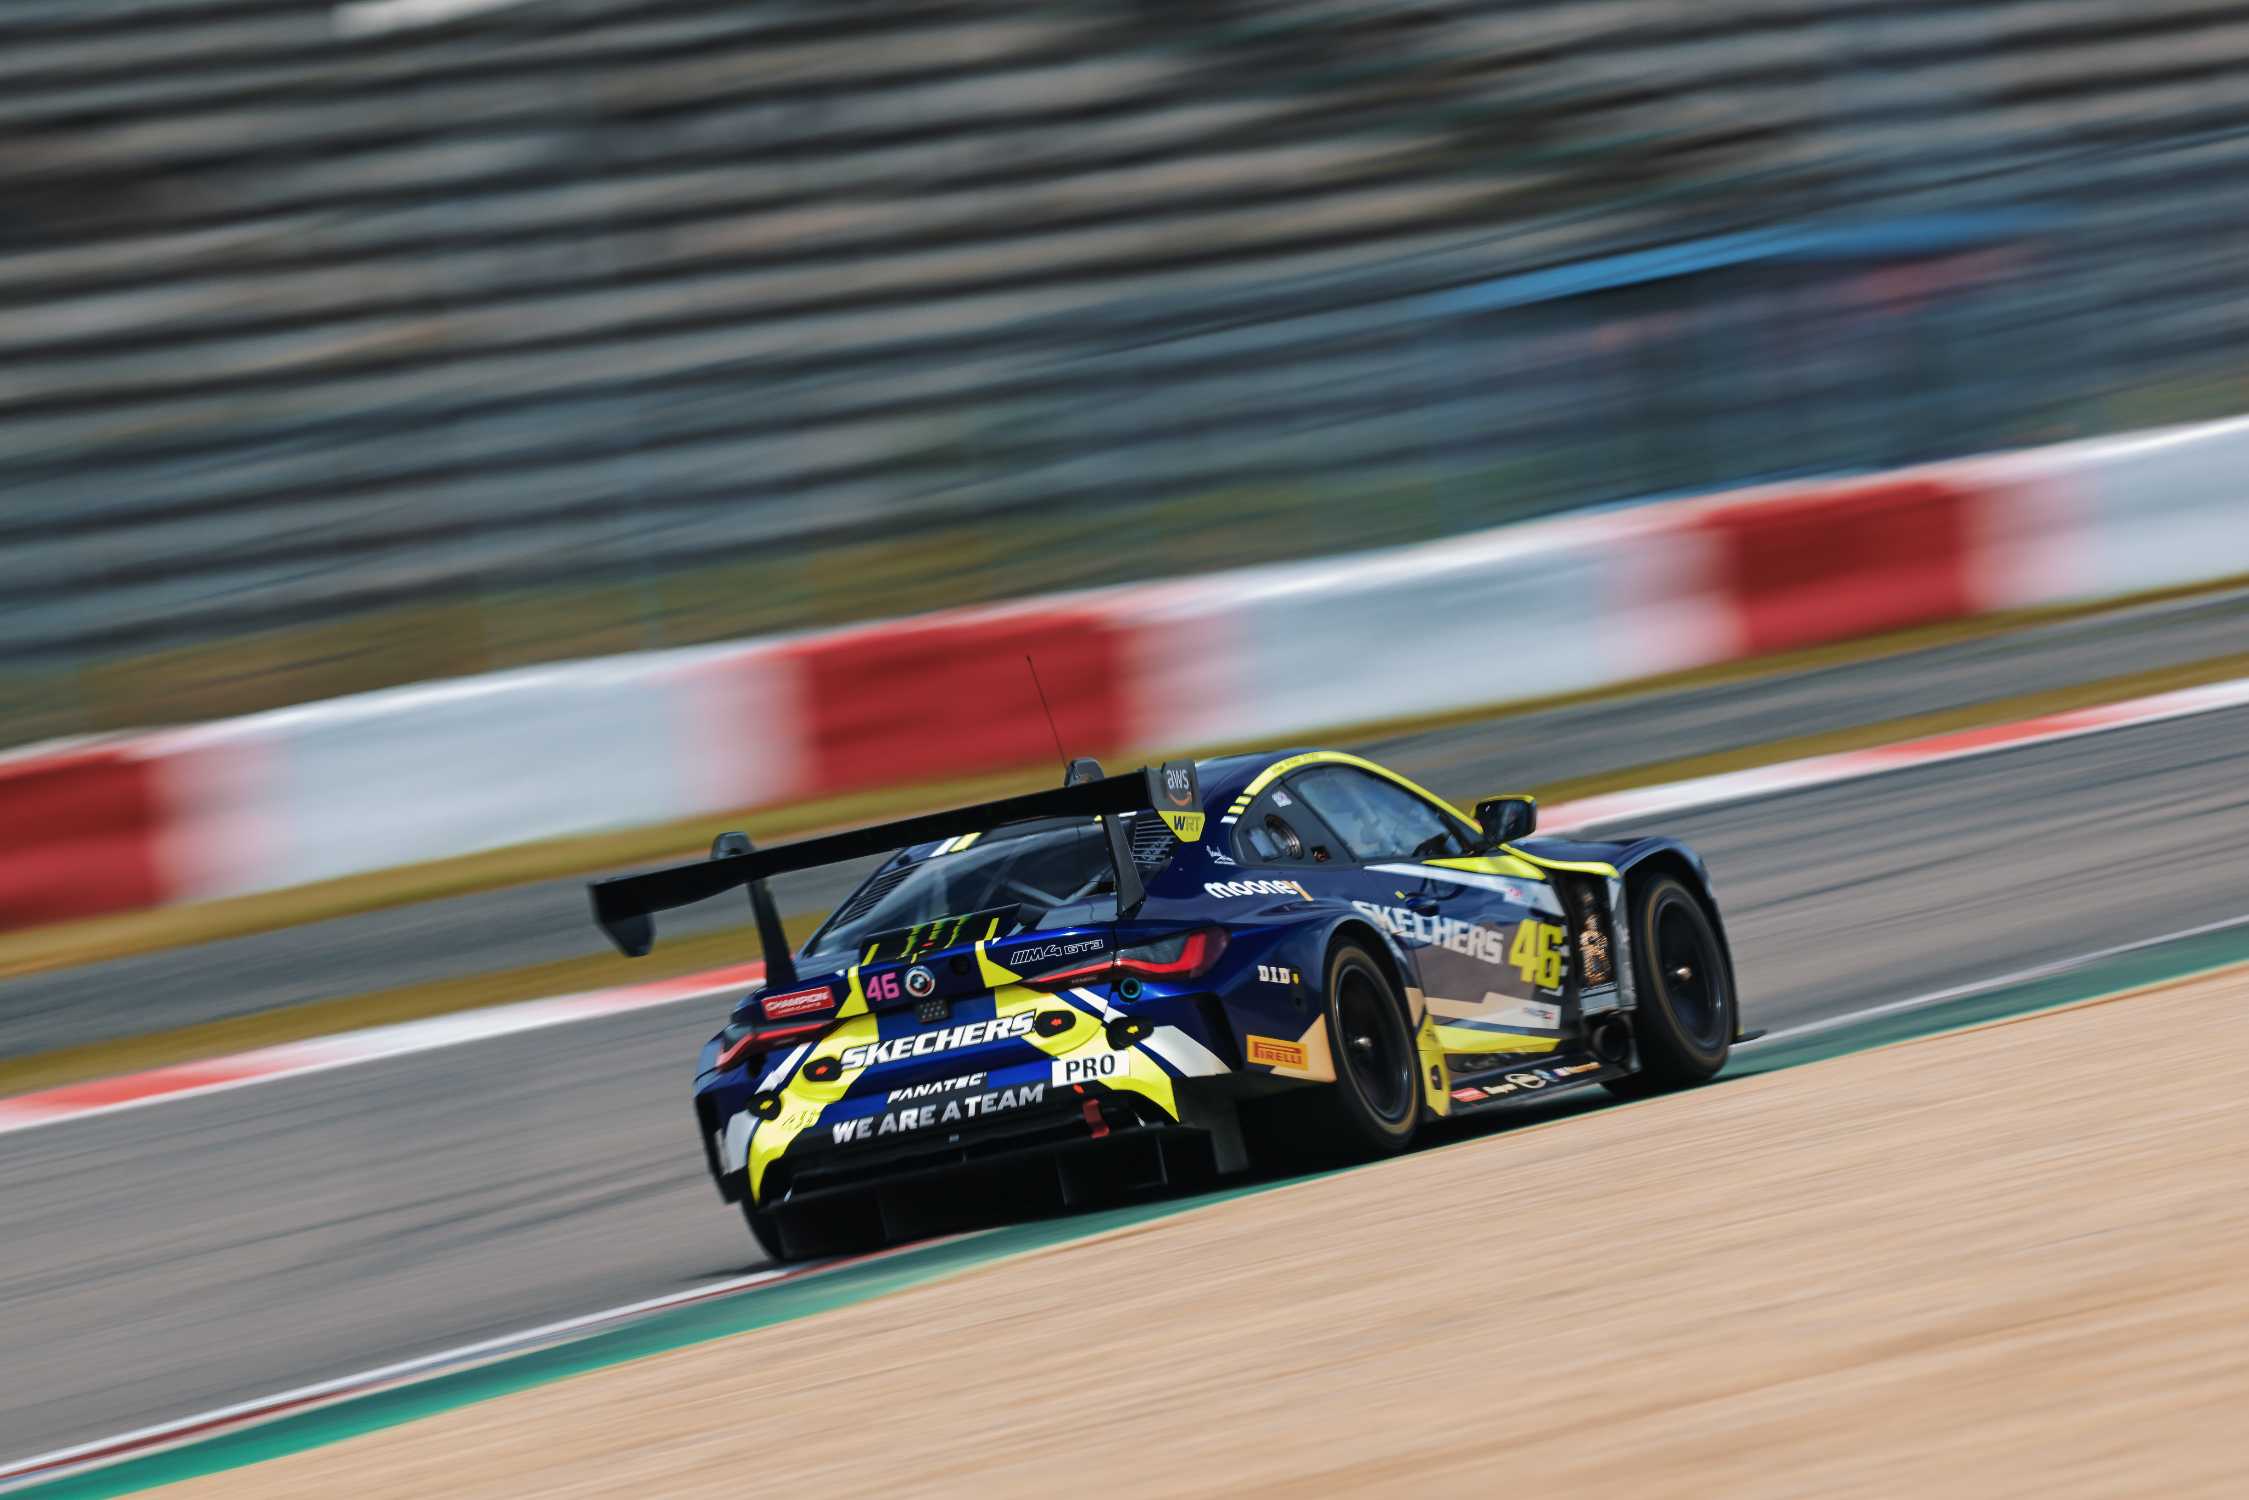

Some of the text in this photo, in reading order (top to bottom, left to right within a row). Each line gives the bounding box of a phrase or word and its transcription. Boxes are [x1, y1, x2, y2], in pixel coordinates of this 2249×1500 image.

[1166, 769, 1190, 790] aws
[1173, 815, 1200, 832] WRT
[1203, 879, 1313, 901] mooney
[1064, 938, 1104, 955] GT3
[1352, 900, 1504, 965] SKECHERS
[1508, 918, 1564, 990] 46
[866, 971, 900, 1002] 46
[840, 1009, 1036, 1071] SKECHERS
[1253, 1041, 1302, 1065] PIRELLI
[1065, 1053, 1116, 1081] PRO
[886, 1072, 987, 1105] FANATEC
[832, 1116, 874, 1145] WE
[878, 1104, 937, 1136] ARE
[940, 1099, 962, 1124] A
[964, 1082, 1045, 1119] TEAM
